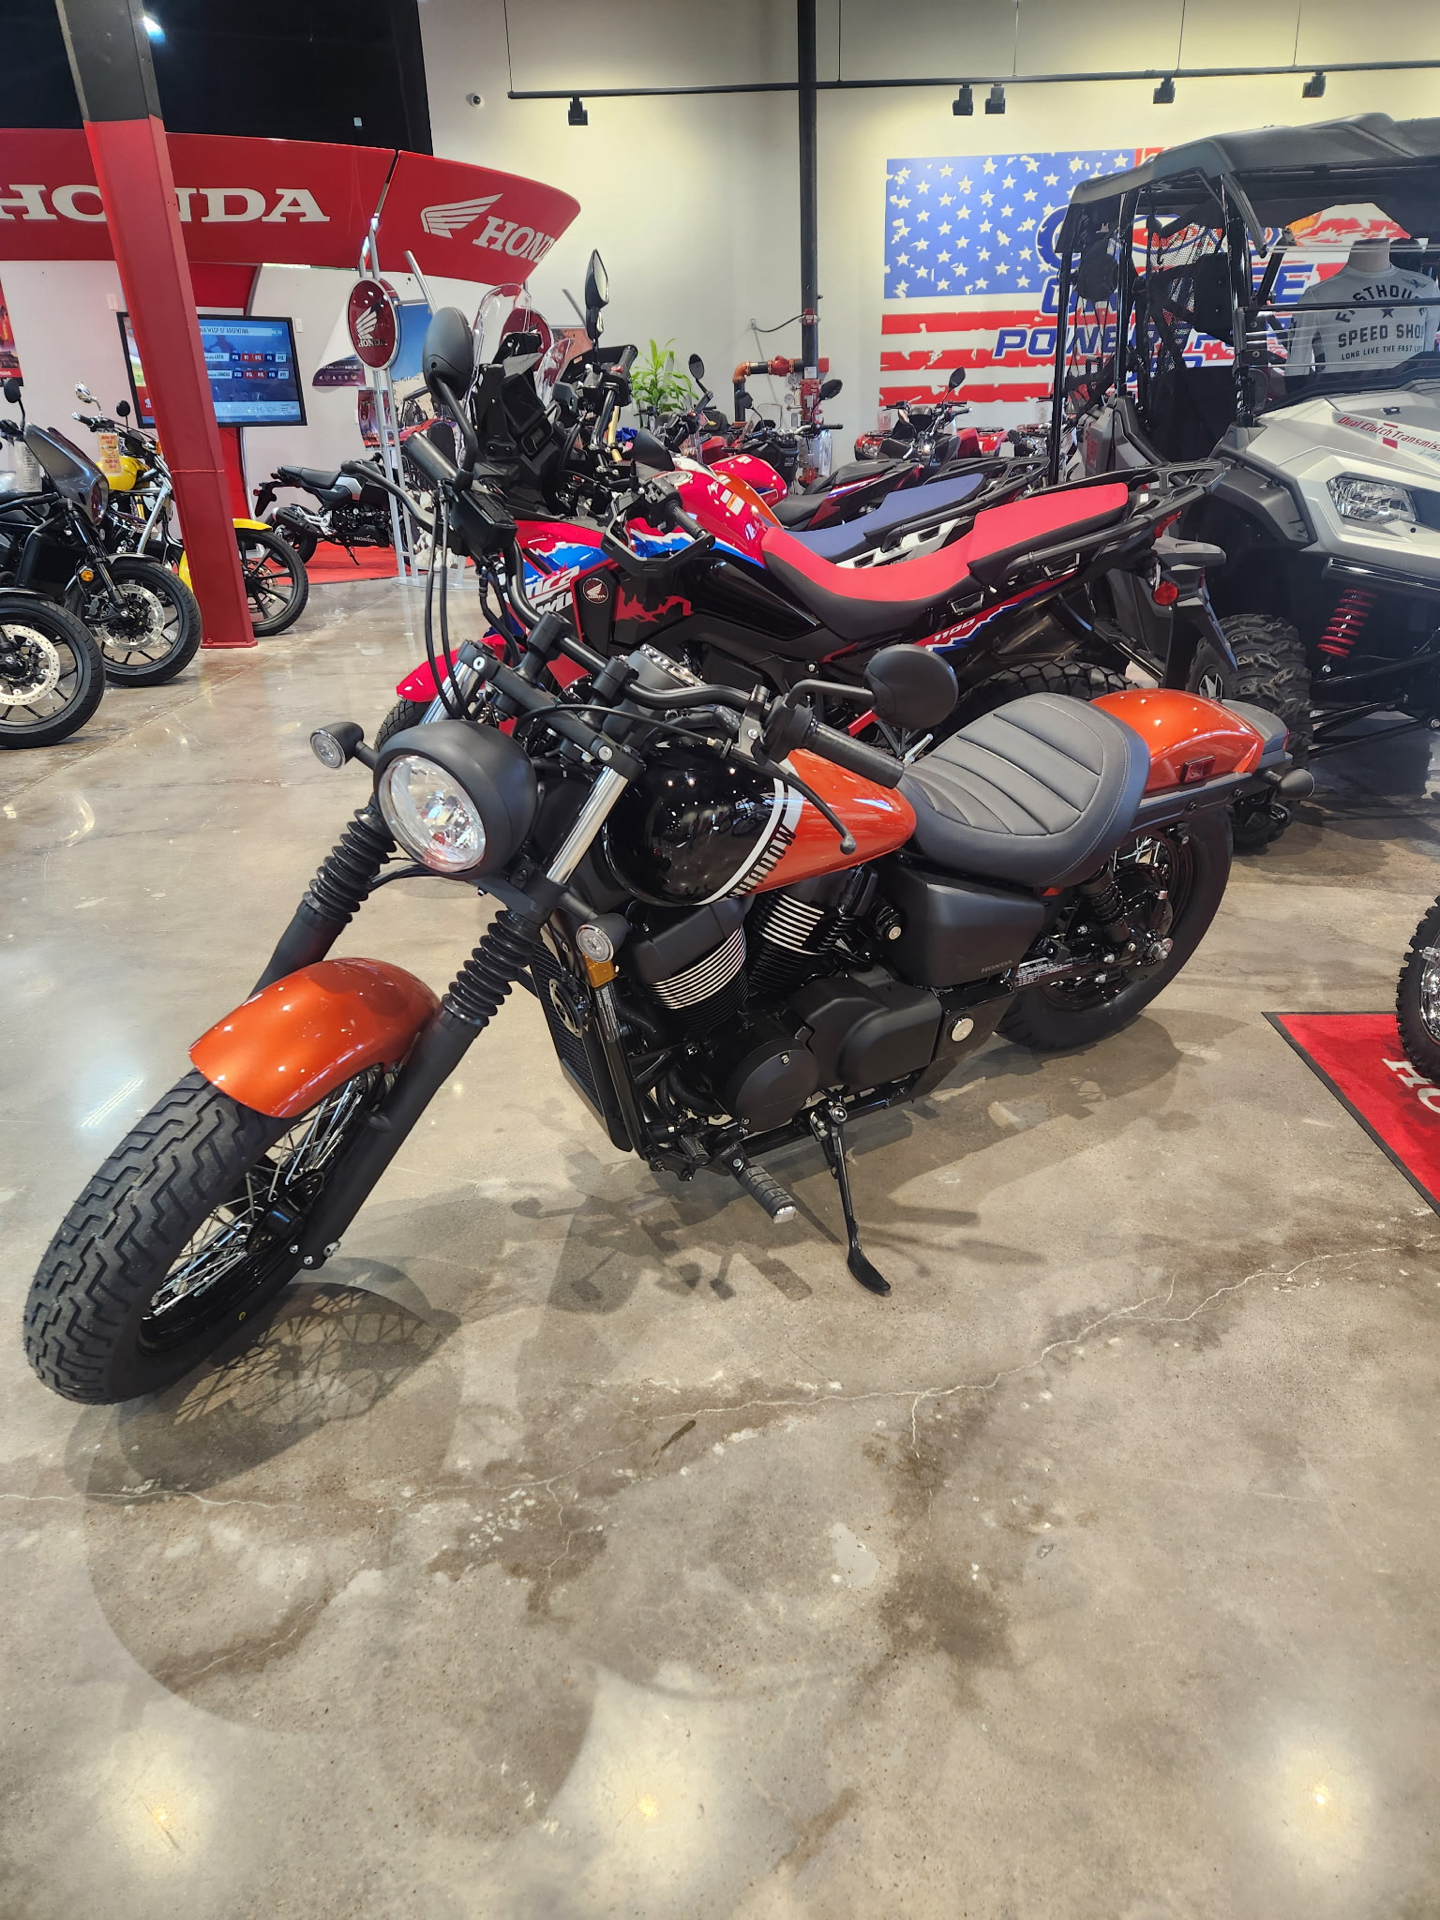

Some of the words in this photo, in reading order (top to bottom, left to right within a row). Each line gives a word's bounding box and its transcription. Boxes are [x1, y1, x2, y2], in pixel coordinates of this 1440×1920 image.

[1338, 324, 1388, 348] SPEED
[1341, 350, 1360, 360] LONG
[1363, 346, 1379, 355] LIVE
[1383, 345, 1395, 353] THE
[1338, 416, 1362, 428] Dual
[1361, 421, 1392, 437] Clutch
[353, 535, 377, 543] HONDA
[934, 618, 975, 641] 1100
[725, 823, 796, 898] SHADOW
[981, 960, 1013, 973] HONDA
